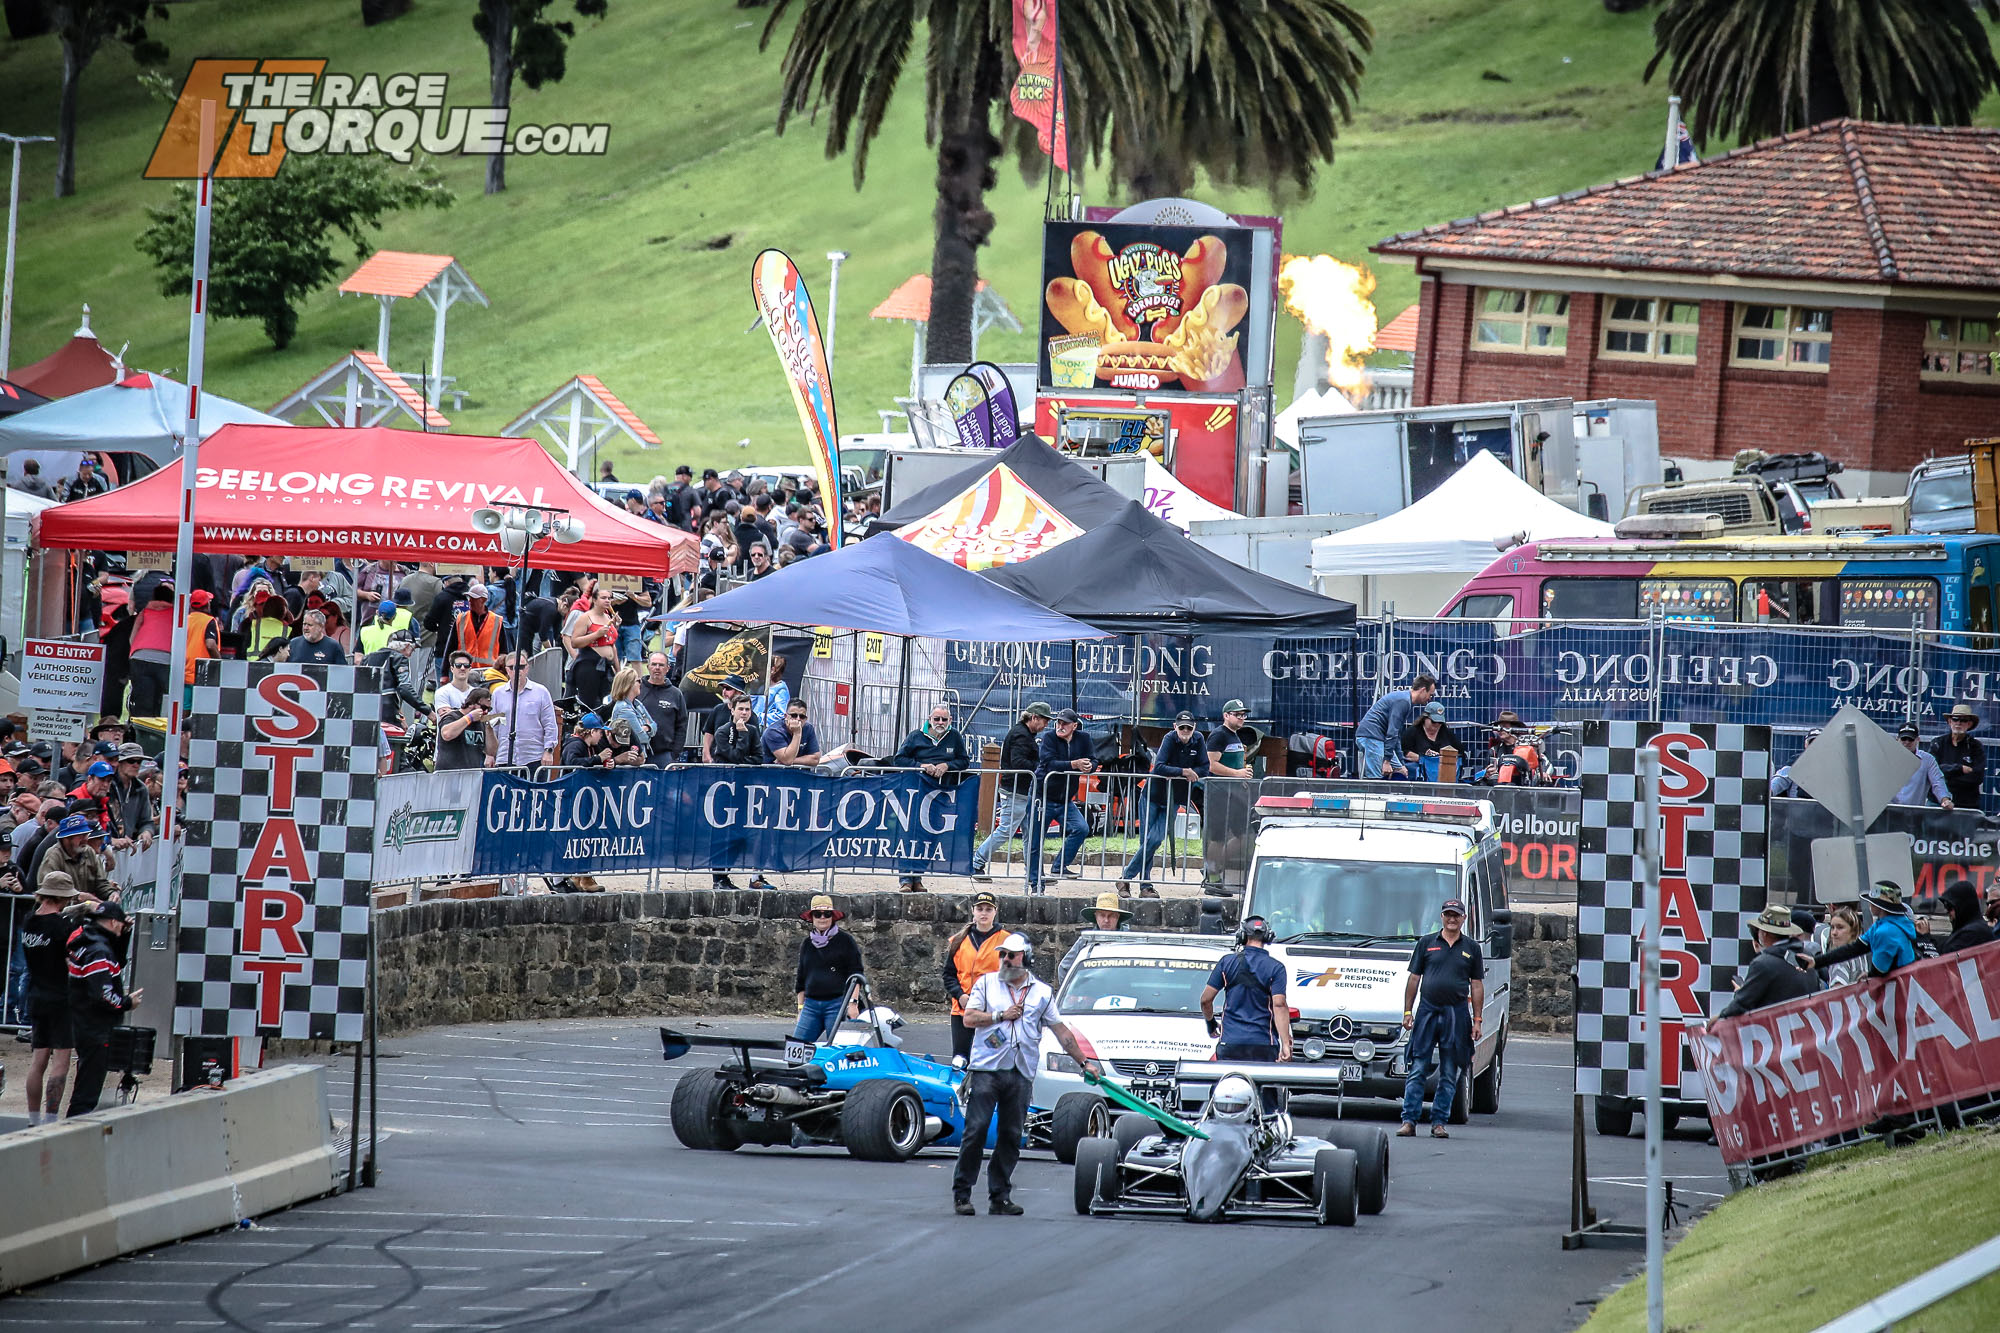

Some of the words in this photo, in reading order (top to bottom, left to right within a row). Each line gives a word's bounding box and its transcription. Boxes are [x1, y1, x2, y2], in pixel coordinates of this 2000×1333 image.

[1019, 86, 1044, 100] DOG
[1108, 251, 1141, 289] UGLY
[1145, 251, 1182, 281] PUGS
[1127, 295, 1181, 318] CORNDOGS
[1112, 374, 1159, 389] JUMBO
[966, 411, 987, 449] SAFFRO
[195, 468, 375, 496] GEELONG
[381, 475, 552, 508] REVIVAL
[225, 493, 362, 505] MOTORING
[384, 500, 474, 514] FESTIV
[1945, 576, 1961, 584] ICE
[815, 633, 831, 649] EXIT
[866, 637, 882, 654] EXIT
[34, 644, 54, 656] NO
[57, 647, 95, 659] ENTRY
[1075, 641, 1216, 679] GEELONG
[33, 663, 92, 674] AUTHORISED
[1262, 648, 1479, 681] GEELONG
[28, 671, 70, 683] VEHICLES
[72, 675, 97, 685] ONLY
[33, 687, 67, 697] PENALTIES
[68, 690, 88, 698] APPLY
[1126, 679, 1211, 696] AUSTRALIA
[837, 695, 848, 705] EXIT
[31, 728, 72, 738] SURVEILLANCE
[486, 780, 655, 834] GEELONG
[703, 779, 959, 836] GEELONG
[410, 814, 458, 836] Club
[241, 673, 319, 1027] START
[562, 836, 646, 860] AUSTRALIA
[822, 837, 948, 862] AUSTRALIA
[1500, 841, 1577, 880] POR
[1636, 732, 1709, 1088] START
[1083, 960, 1131, 968] VICTORIAN
[1159, 960, 1166, 968] &
[1169, 961, 1209, 970] RESCUE
[1340, 967, 1398, 977] EMERGENCY
[1335, 982, 1373, 990] SERVICES
[1344, 975, 1390, 983] RESPONSE
[1110, 997, 1121, 1007] R
[1737, 958, 2000, 1106] REVIVAL
[787, 1045, 803, 1059] 162
[838, 1056, 880, 1071] MAZDA
[1342, 1066, 1361, 1078] BNZ
[1769, 1070, 1931, 1138] FESTIVAL
